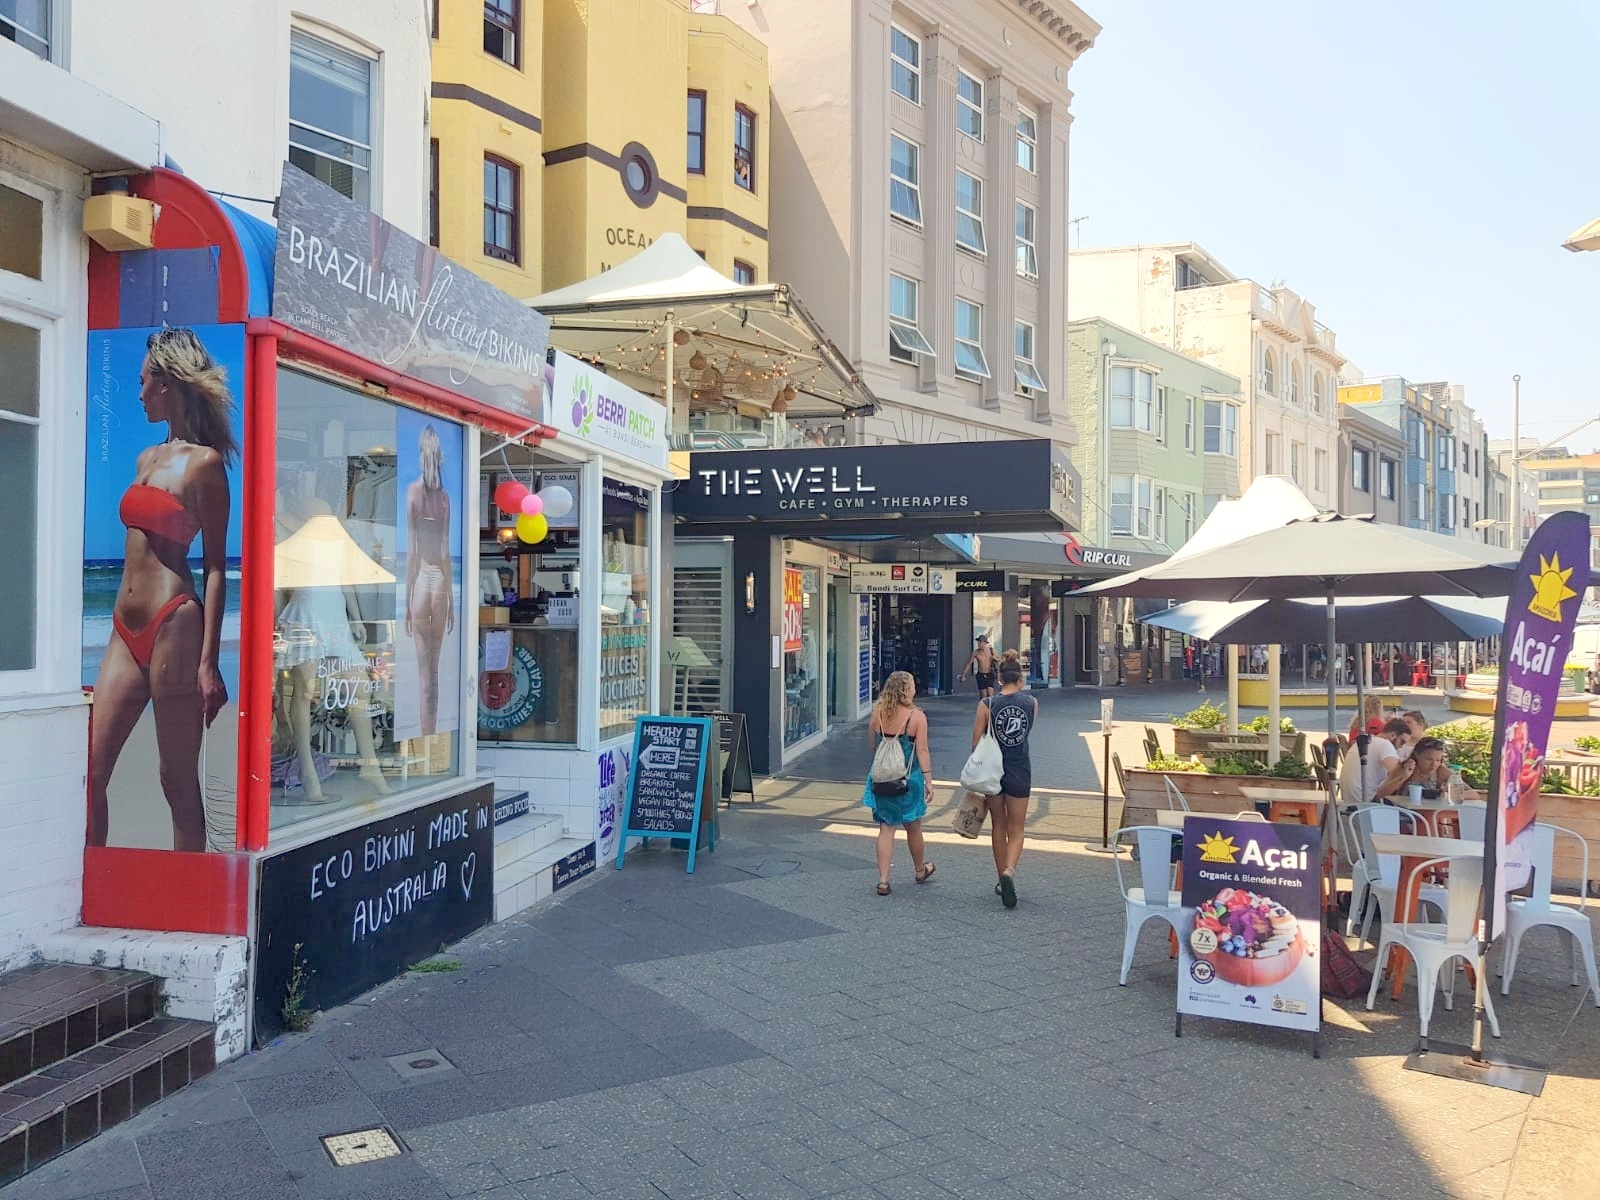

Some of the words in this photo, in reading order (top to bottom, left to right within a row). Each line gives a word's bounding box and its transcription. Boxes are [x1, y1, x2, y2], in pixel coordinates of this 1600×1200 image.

[289, 225, 417, 319] BRAZILIAN
[380, 265, 489, 386] flirting
[487, 328, 541, 378] BIKINIS
[301, 305, 319, 320] BONDI
[319, 312, 339, 326] BEACH
[596, 393, 627, 428] BERRI
[627, 409, 656, 441] PATCH
[604, 426, 611, 436] AT
[698, 468, 763, 496] THE
[771, 465, 876, 494] WELL
[779, 499, 816, 510] CAFE
[833, 498, 865, 509] GYM
[881, 495, 969, 508] THERAPIES
[1083, 550, 1104, 564] RIP
[1103, 553, 1132, 567] CURL
[867, 584, 890, 592] Bondi
[893, 584, 911, 592] Surf
[912, 584, 926, 592] Co.
[1510, 620, 1561, 676] Açaí
[318, 655, 352, 679] BIKINI
[601, 654, 639, 678] JUICES
[324, 676, 360, 711] 30%
[363, 679, 382, 694] OFF
[478, 701, 534, 729] MOOTHIES
[518, 647, 537, 668] BAR
[643, 724, 683, 738] HEALTHY
[652, 736, 681, 746] START
[650, 751, 676, 763] HERE
[641, 769, 668, 779] ORGANIC
[639, 779, 676, 789] BREAKFAST
[639, 786, 676, 798] SANDWICH
[639, 796, 661, 807] VEGAN
[636, 807, 672, 819] SMOOTHIES
[311, 849, 353, 901] ECO
[428, 808, 470, 850] MADE
[1241, 838, 1310, 872] Açaí
[1199, 869, 1233, 881] Organic
[1233, 873, 1240, 882] &
[1242, 874, 1277, 886] Blended
[1278, 877, 1303, 888] Fresh
